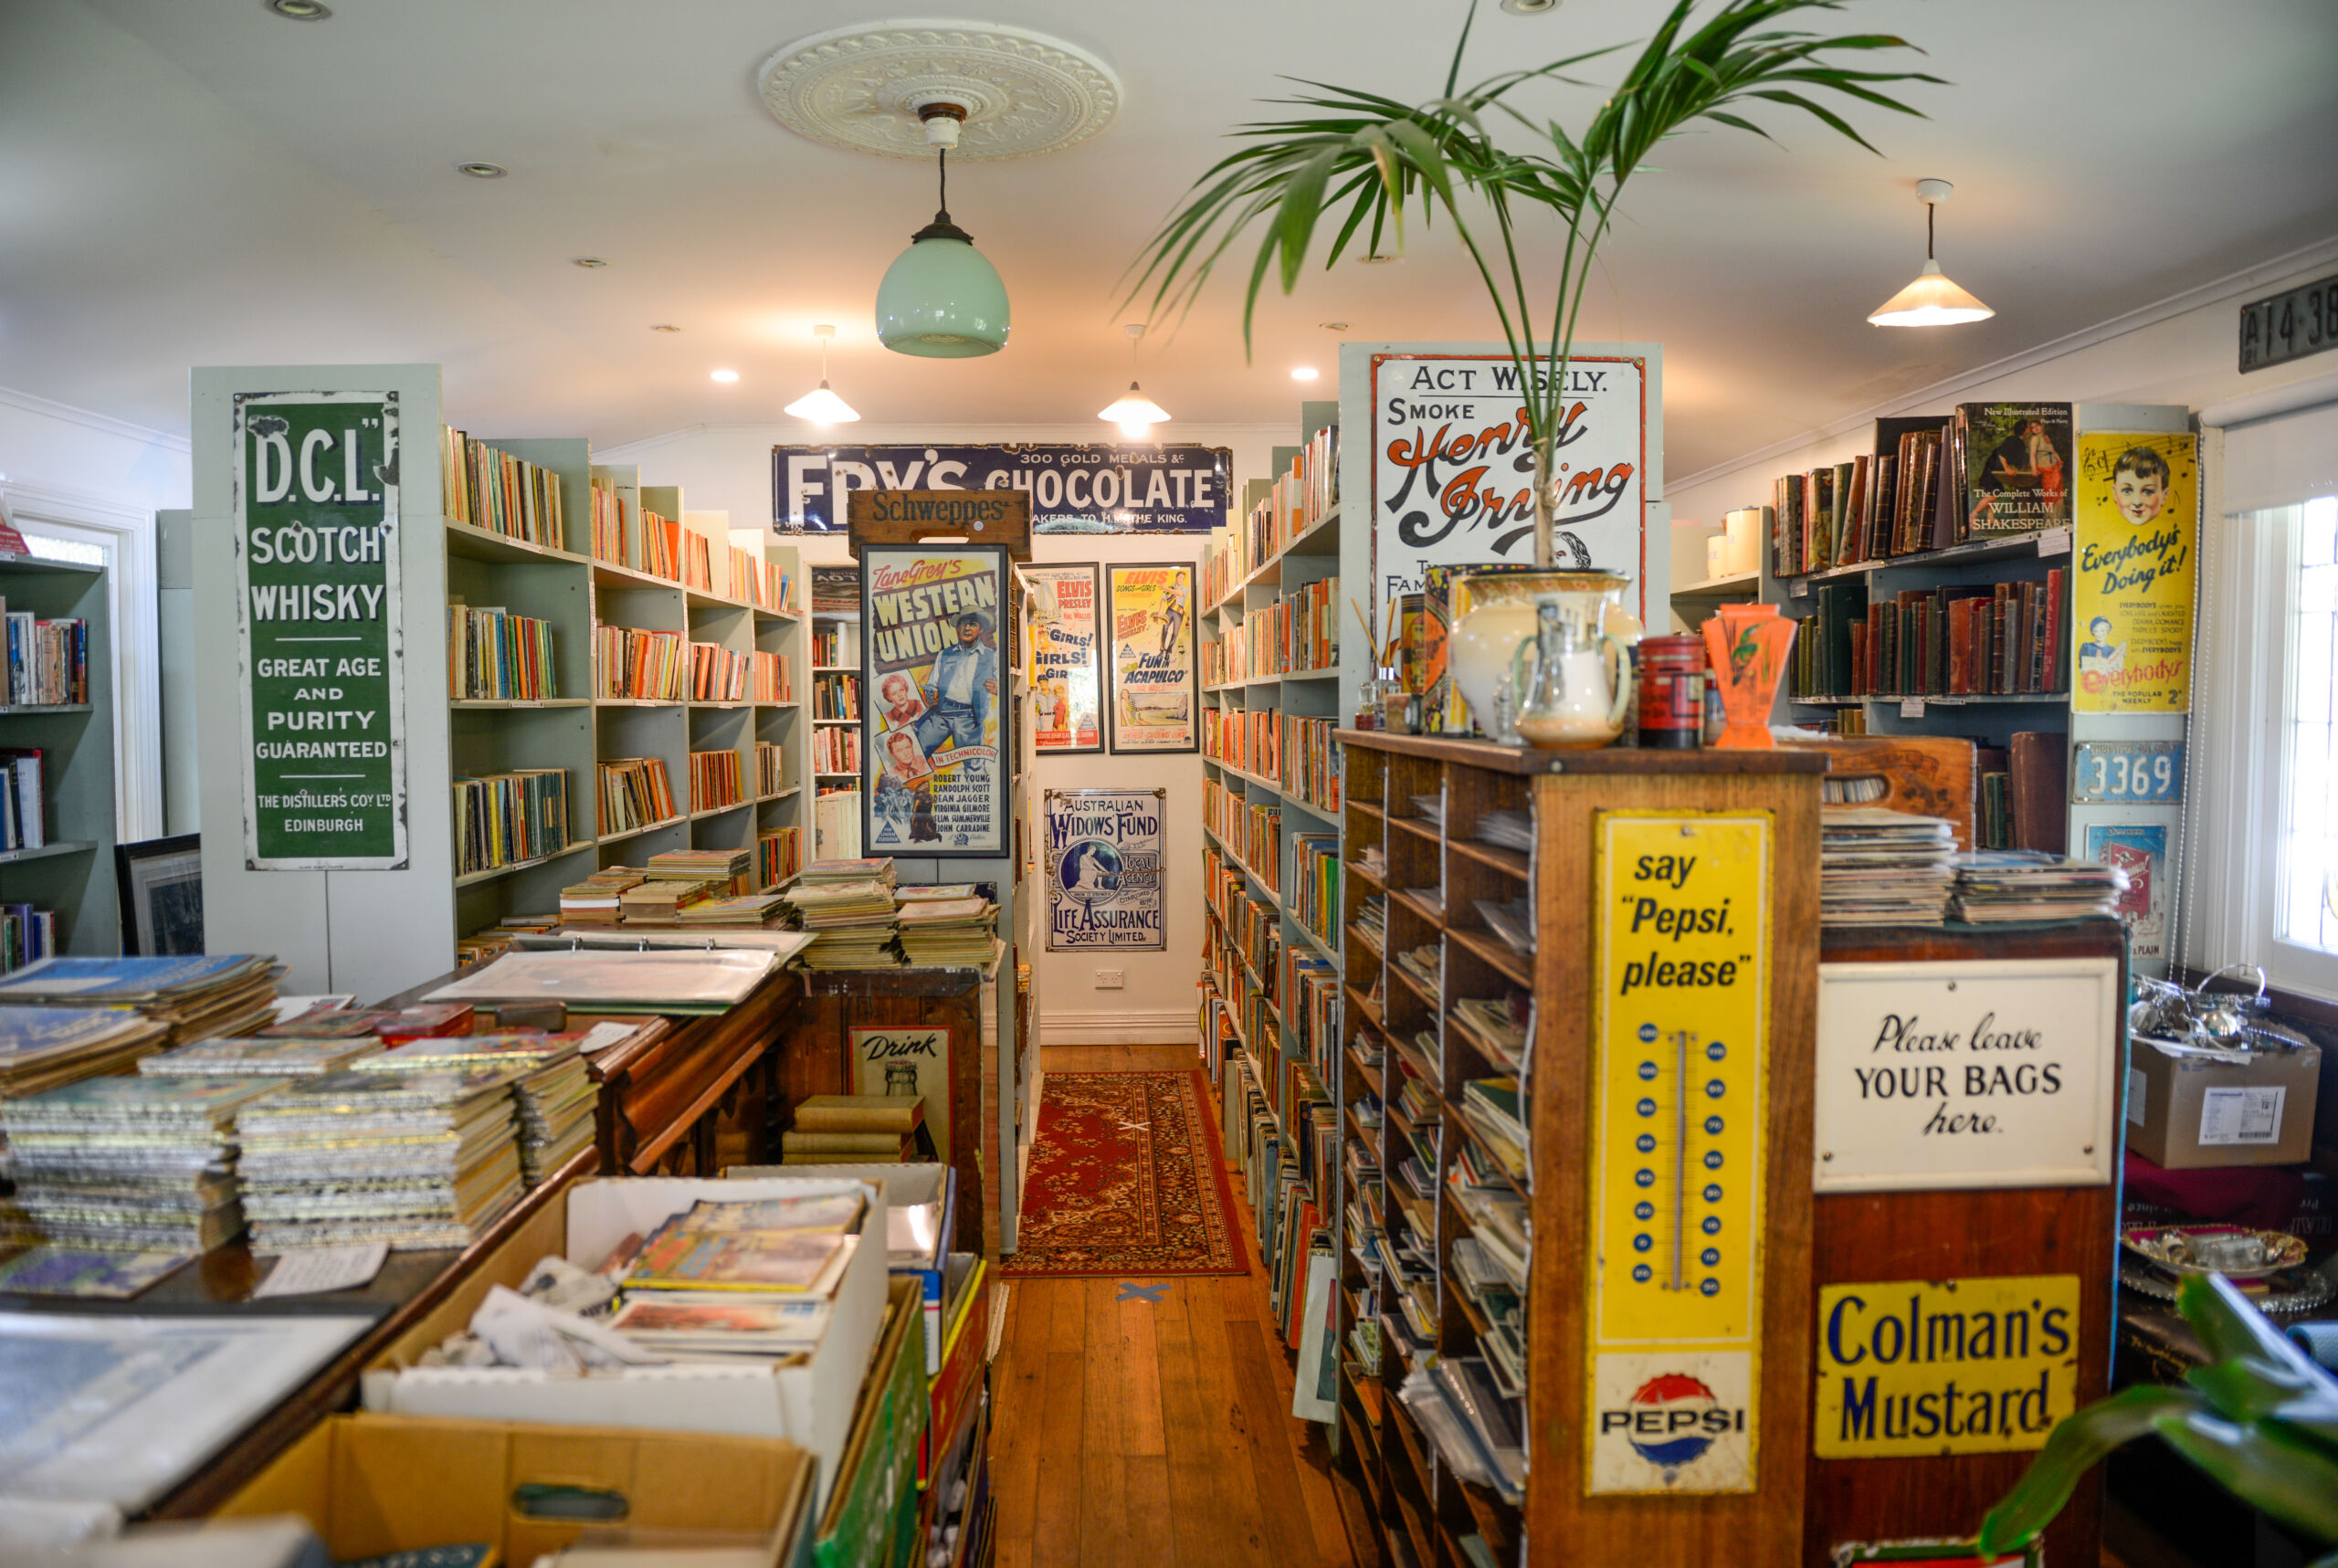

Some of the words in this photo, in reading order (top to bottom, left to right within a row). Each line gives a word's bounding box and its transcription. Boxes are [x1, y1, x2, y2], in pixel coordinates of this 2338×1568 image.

[1410, 365, 1477, 391] ACT
[1491, 366, 1607, 392] WSELY.
[1387, 397, 1475, 426] SMOKE
[1985, 407, 2003, 416] New
[2041, 407, 2068, 416] Edition
[1020, 454, 1052, 464] 300
[1060, 454, 1102, 464] GOLD
[1109, 454, 1167, 464] MEDALS
[985, 468, 1216, 509] CHOCOLATE
[1973, 489, 1991, 498] The
[1993, 489, 2031, 500] Complete
[2032, 489, 2059, 498] Works
[2059, 488, 2068, 497] of
[872, 491, 1005, 526] Schweppes
[1988, 502, 2054, 513] WILLIAM
[1029, 513, 1073, 524] AKERS
[1081, 513, 1098, 524] TO
[1156, 513, 1187, 524] KING.
[1973, 518, 2070, 530] SHAKESPEARE
[251, 526, 383, 564] SCOTCH
[2081, 524, 2181, 573] Everybody's
[1124, 571, 1169, 584] ELVIS
[2101, 566, 2154, 595] Doing
[2159, 545, 2186, 575] it!
[1057, 581, 1092, 598] ELVIS
[251, 584, 385, 621] WHISKY
[873, 574, 996, 627] WESTERN
[1058, 598, 1092, 609] PRESLEY
[1117, 609, 1147, 634] ELVIS
[876, 618, 961, 665] UNION
[258, 658, 330, 678] GREAT
[336, 658, 382, 677] AGE
[2081, 658, 2184, 694] everybody's
[293, 688, 344, 701] AND
[268, 710, 376, 731] PURITY
[256, 741, 388, 760] GUARANTEED
[935, 755, 944, 764] IN
[945, 748, 995, 762] TECHNICOLOR
[2089, 755, 2172, 795] 3369
[933, 784, 969, 793] RANDOLPH
[972, 784, 991, 793] SCOTT
[933, 795, 954, 803] DEAN
[956, 795, 990, 803] JAGGER
[258, 795, 279, 808] THE
[933, 805, 960, 813] VIRGINIA
[963, 805, 990, 813] GILMORE
[1064, 800, 1143, 812] AUSTRALIAN
[285, 818, 363, 832] EDINBURGH
[933, 815, 949, 823] SLIM
[952, 815, 990, 823] SUMMERVILLE
[1116, 813, 1158, 845] FUND
[1124, 855, 1152, 871] LOCAL
[1634, 855, 1697, 889] say
[1053, 893, 1079, 934] LIFE
[1079, 898, 1159, 931] ASSURANCE
[1066, 930, 1107, 944] SOCIETY
[2138, 944, 2160, 955] PLAIN
[1871, 1014, 1961, 1053] Please
[1968, 1011, 2044, 1051] leave
[861, 1033, 937, 1061] Drink
[1854, 1066, 1950, 1100] YOUR
[1964, 1063, 2063, 1097] BAGS
[1922, 1101, 2004, 1136] here.
[1827, 1293, 2071, 1366] Colman's
[1839, 1369, 2052, 1442] Mustard
[1601, 1409, 1744, 1436] PEPSI
